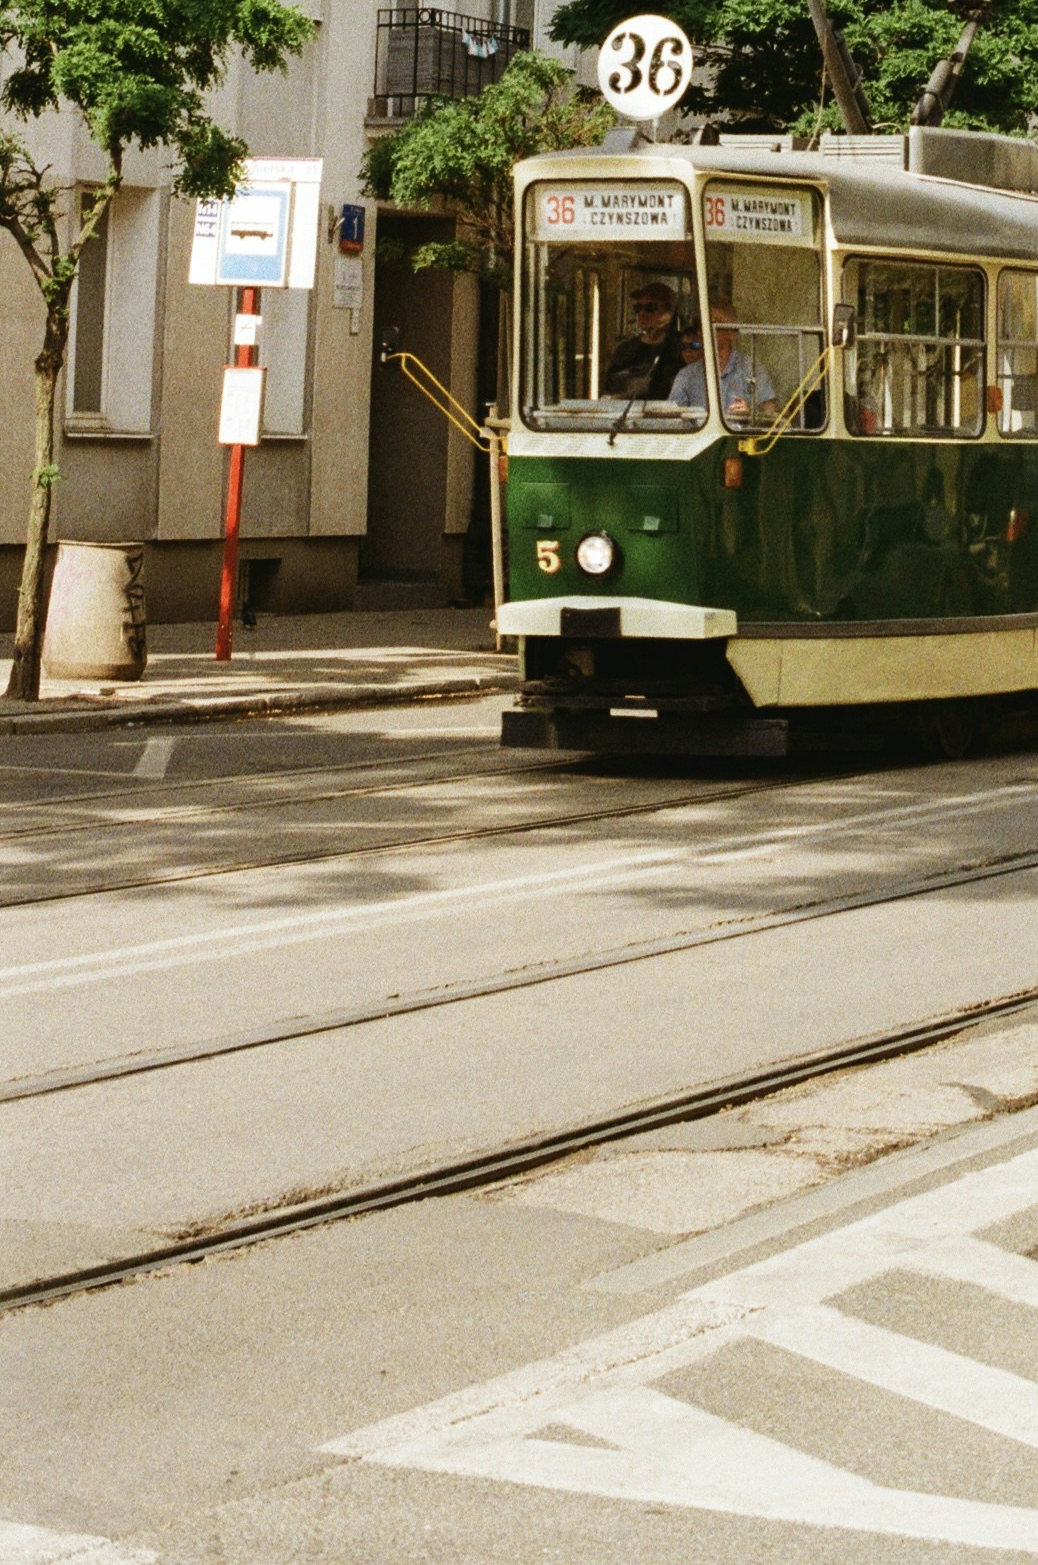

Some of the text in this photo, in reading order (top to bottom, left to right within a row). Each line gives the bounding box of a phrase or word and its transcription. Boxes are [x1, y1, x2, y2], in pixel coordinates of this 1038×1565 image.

[608, 32, 684, 96] 36
[547, 194, 675, 225] 36 M. MARYMONT
[591, 211, 668, 225] CZYNSZOWA
[705, 197, 726, 226] 36
[743, 199, 796, 216] MARYMONT
[736, 215, 793, 232] CZYNSZOWA
[536, 539, 561, 574] 5
